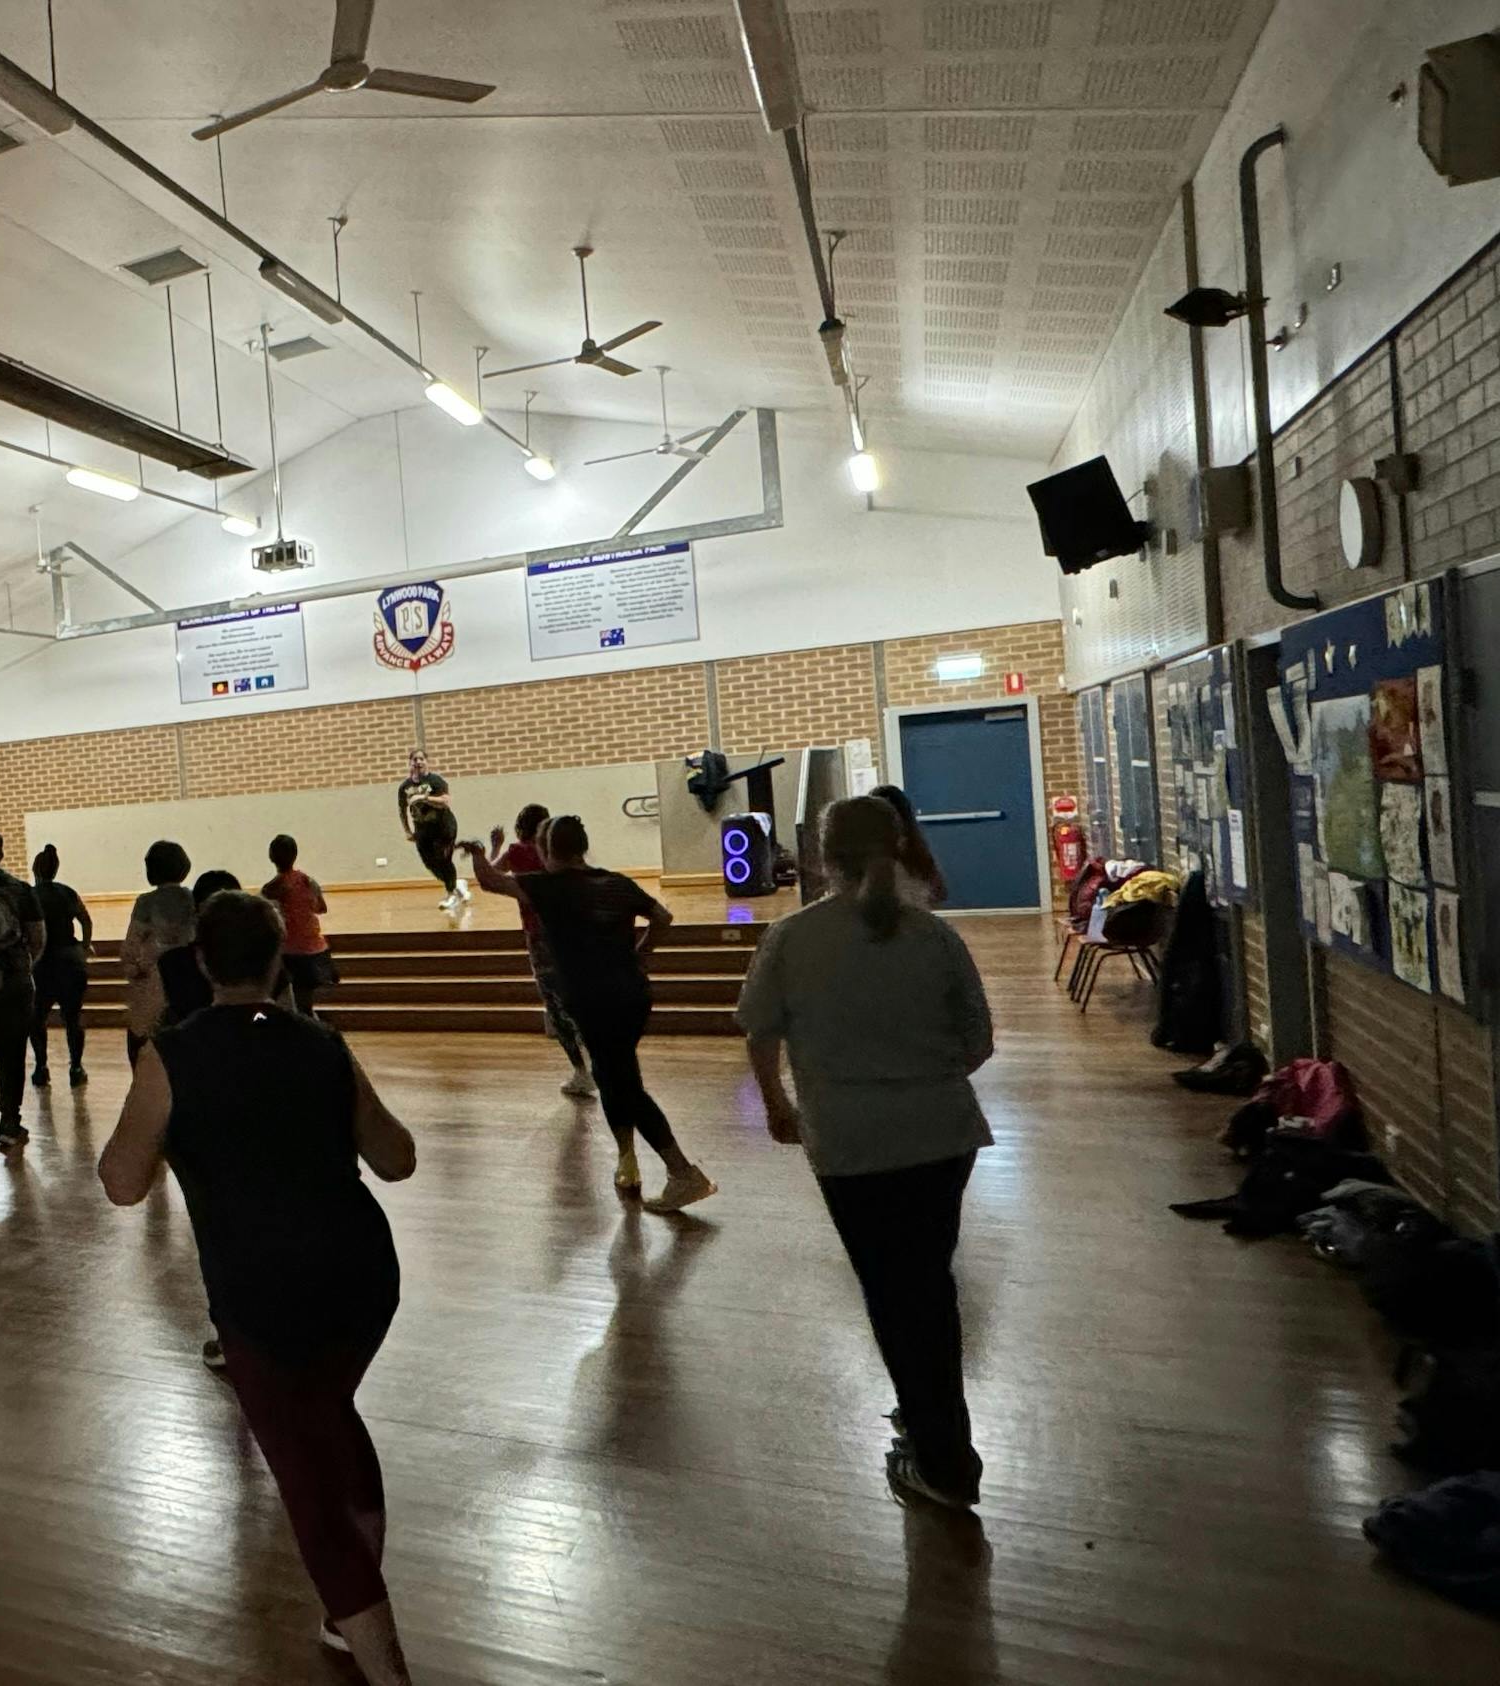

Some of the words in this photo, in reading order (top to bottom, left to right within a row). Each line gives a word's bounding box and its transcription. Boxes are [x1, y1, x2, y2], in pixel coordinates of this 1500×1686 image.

[382, 586, 417, 611] LYNWOOD
[417, 585, 441, 603] PARK
[375, 633, 411, 668] ADVANCE
[419, 625, 453, 667] ALWAYS
